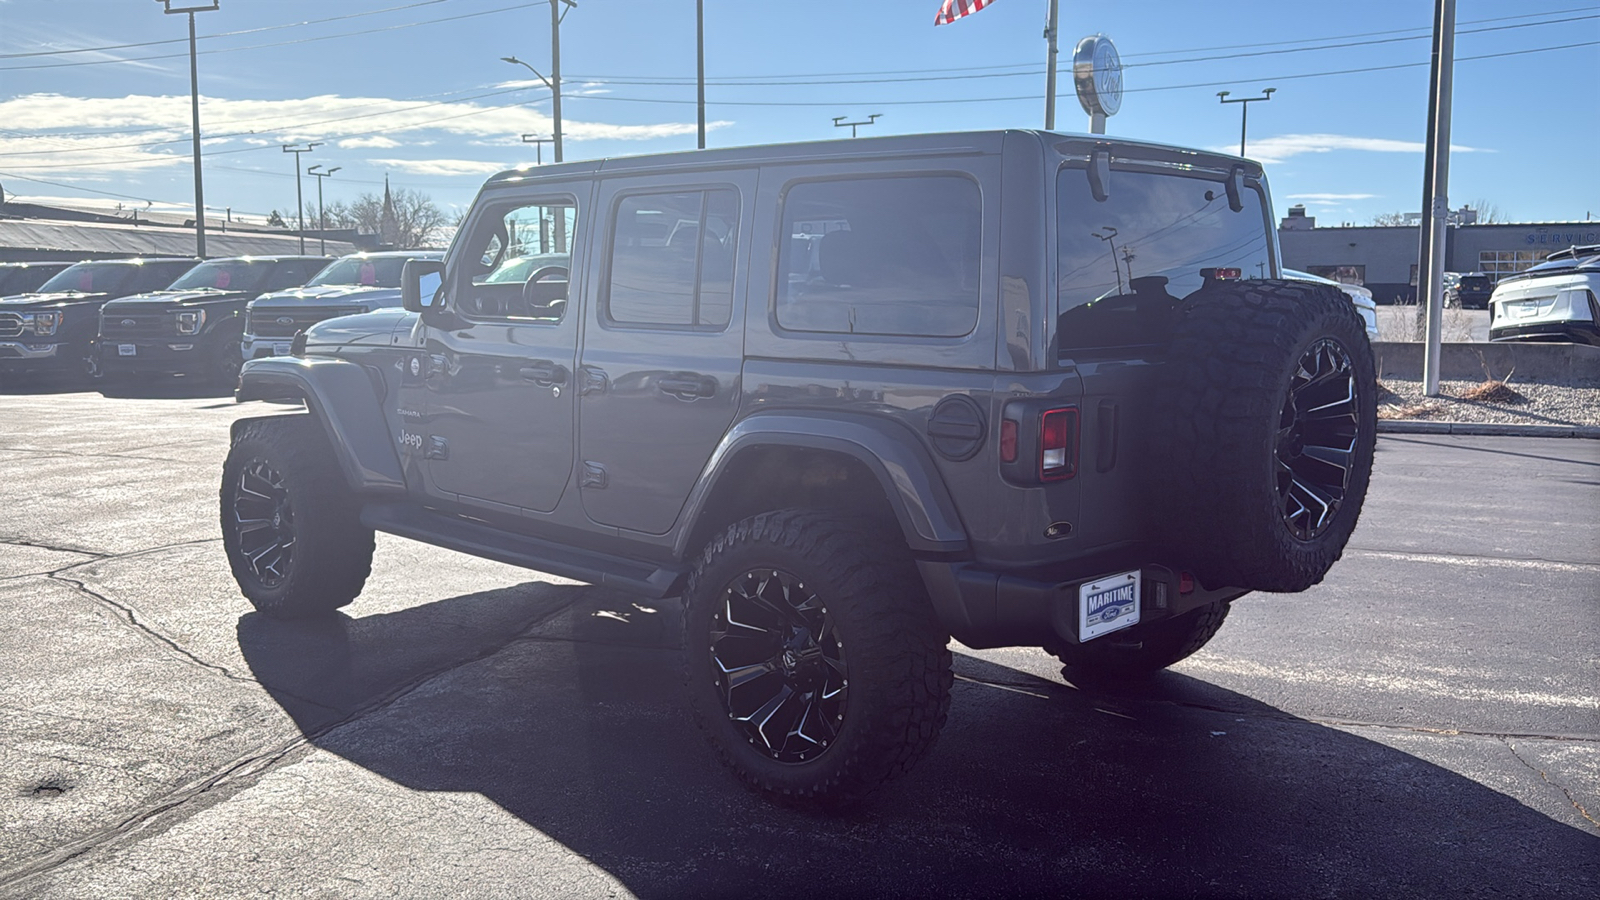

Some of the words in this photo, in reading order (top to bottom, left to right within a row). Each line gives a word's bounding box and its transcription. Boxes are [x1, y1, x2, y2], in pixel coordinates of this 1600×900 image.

[398, 429, 422, 449] Jeep
[1088, 585, 1133, 614] MARITIME
[1103, 607, 1118, 620] Ford
